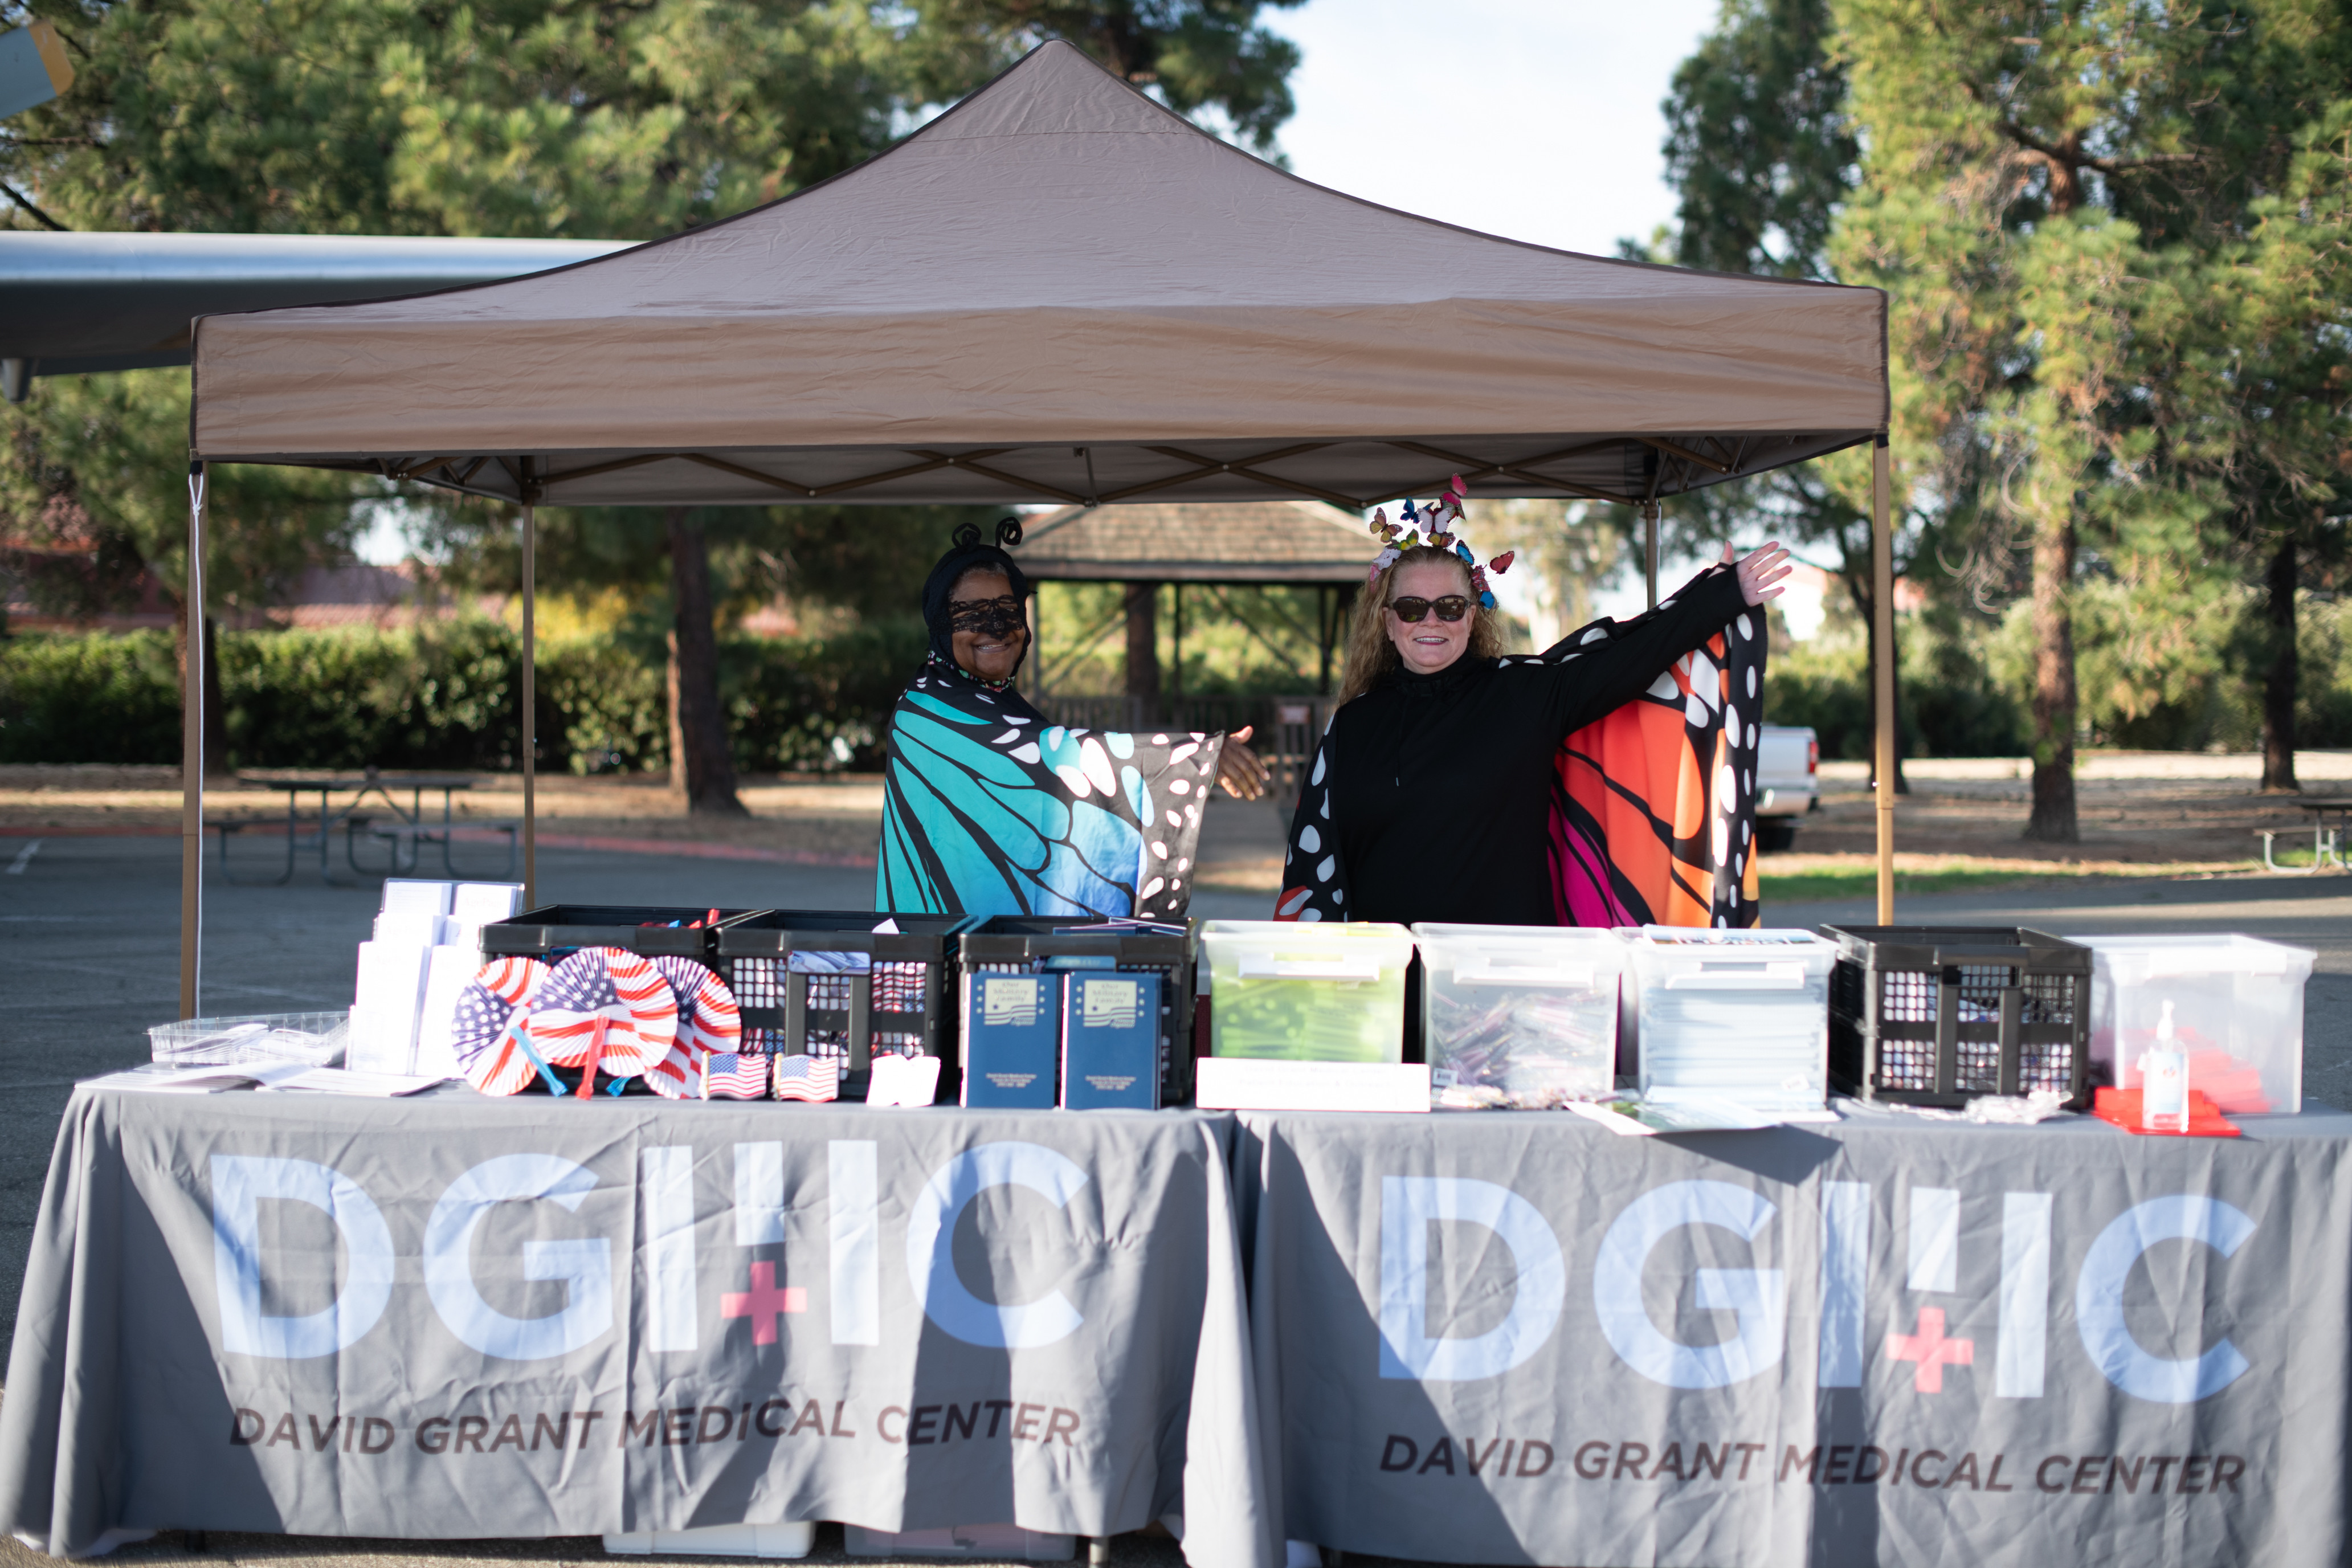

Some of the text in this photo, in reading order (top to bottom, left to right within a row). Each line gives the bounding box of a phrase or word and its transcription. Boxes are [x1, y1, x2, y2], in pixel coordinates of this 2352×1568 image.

[230, 1397, 1083, 1456] DAVID GRANT MEDICAL CENTER
[1379, 1435, 2247, 1495] DAVID GRANT MEDICAL CENTER
